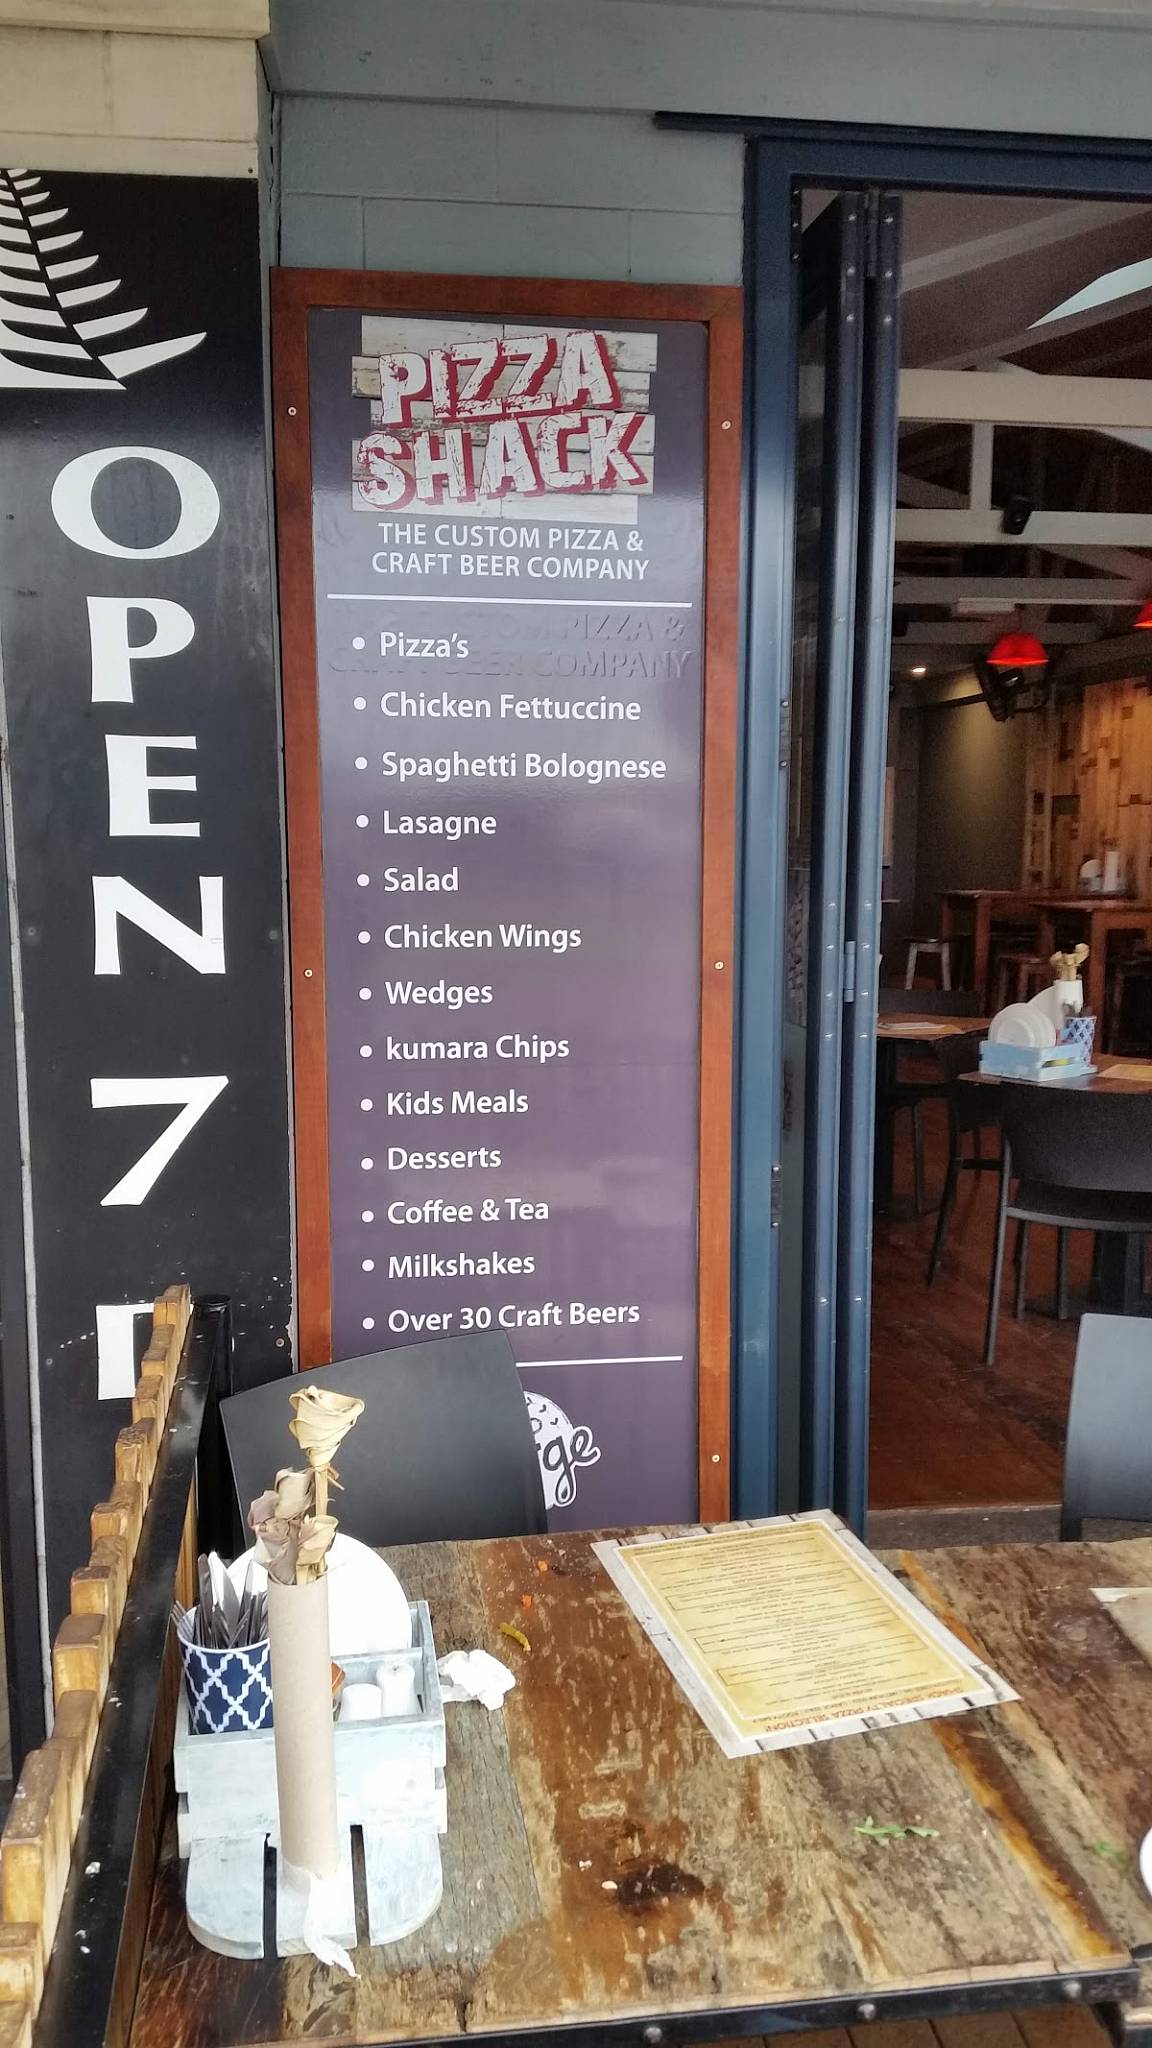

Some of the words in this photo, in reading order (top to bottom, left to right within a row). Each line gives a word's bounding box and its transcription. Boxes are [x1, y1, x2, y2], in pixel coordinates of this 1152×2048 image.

[378, 331, 620, 427] PIZZA
[357, 412, 648, 509] SHACK
[377, 522, 427, 545] THE
[434, 524, 540, 549] CUSTOM
[548, 528, 620, 551] PIZZA
[626, 530, 644, 552] &
[372, 551, 453, 575] CRAFT
[460, 554, 520, 577] BEER
[527, 556, 650, 580] COMPANY
[50, 446, 226, 976] OPEN
[380, 691, 491, 718] Chicken
[500, 694, 641, 721] Fettuccine
[382, 751, 516, 783] Spaghetti
[525, 752, 667, 785] Bolognese
[383, 810, 497, 841] Lasagne
[384, 866, 459, 892] Salad
[384, 923, 493, 949] Chicken
[498, 923, 582, 954] Wings
[384, 979, 493, 1010] Wedges
[386, 1036, 488, 1060] kumara
[495, 1033, 570, 1064] Chips
[387, 1090, 444, 1116] Kids
[451, 1088, 529, 1114] Meals
[90, 1075, 229, 1207] 7
[388, 1147, 502, 1170] Desserts
[387, 1198, 474, 1225] Coffee
[480, 1198, 500, 1222] &
[504, 1197, 549, 1221] Tea
[388, 1251, 535, 1279] Milkshakes
[388, 1309, 453, 1333] Over
[459, 1306, 492, 1330] 30
[498, 1302, 563, 1328] Craft
[569, 1302, 640, 1325] Beers
